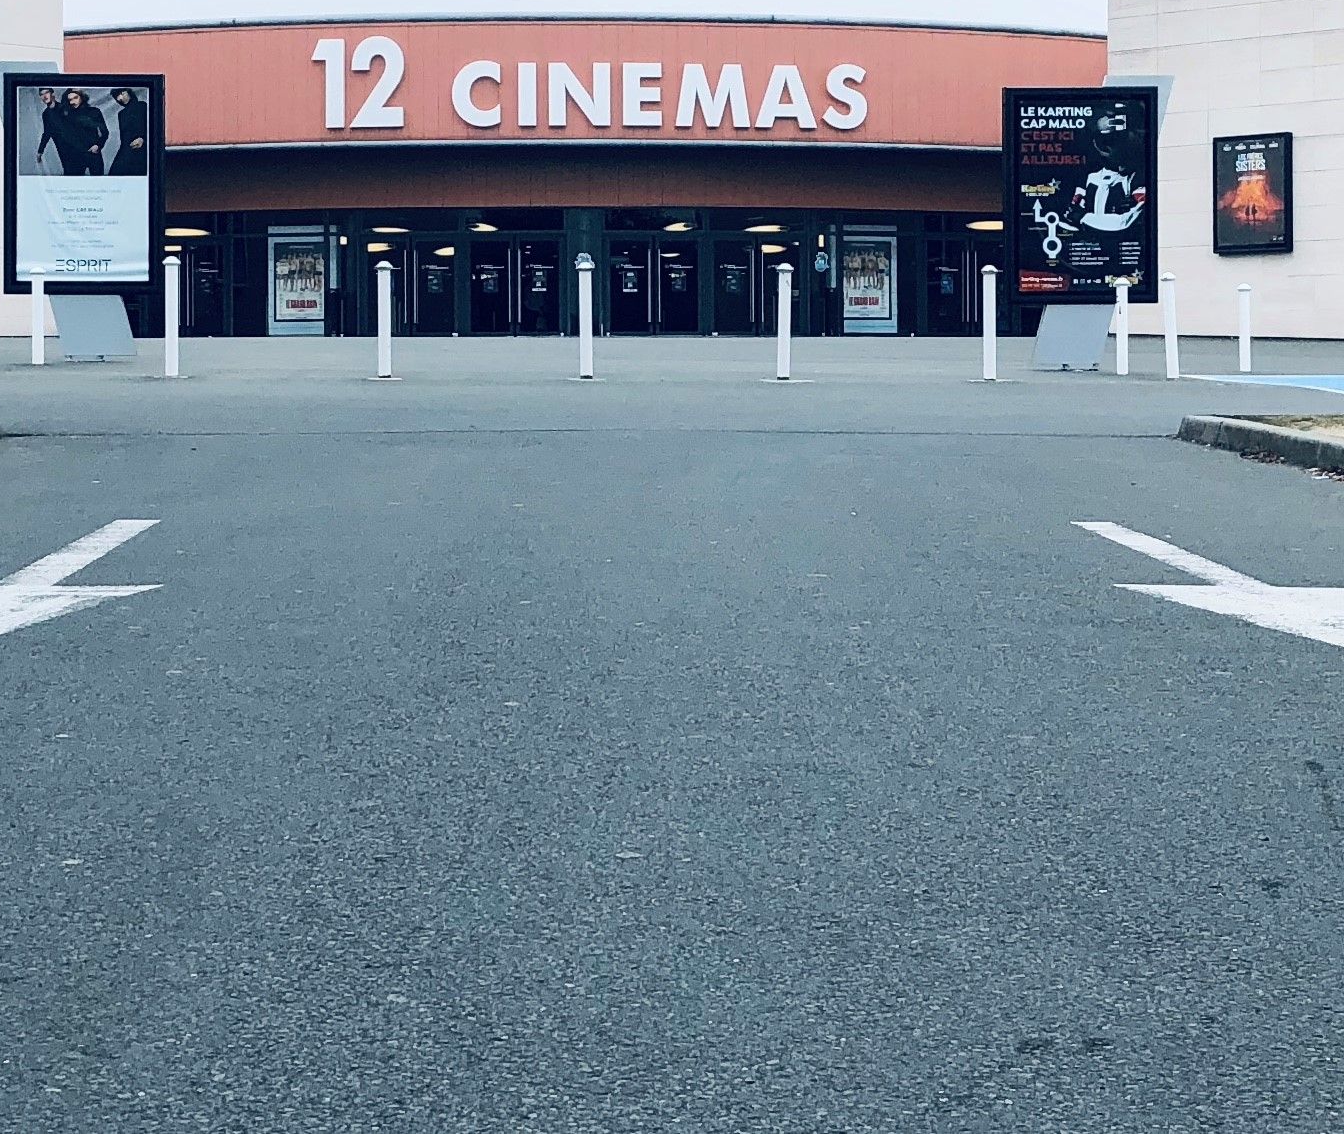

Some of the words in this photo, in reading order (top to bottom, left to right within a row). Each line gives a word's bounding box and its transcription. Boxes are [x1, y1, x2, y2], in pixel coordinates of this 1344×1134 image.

[311, 35, 405, 130] 12
[452, 60, 869, 131] CINEMAS
[1020, 106, 1035, 117] LE
[1037, 106, 1093, 117] KARTING
[1020, 118, 1047, 129] CAP
[1048, 118, 1086, 129] MALO
[1021, 143, 1036, 153] ET
[1039, 143, 1063, 153] PAS
[1235, 159, 1266, 172] SISTERS
[55, 258, 112, 272] ESPRIT
